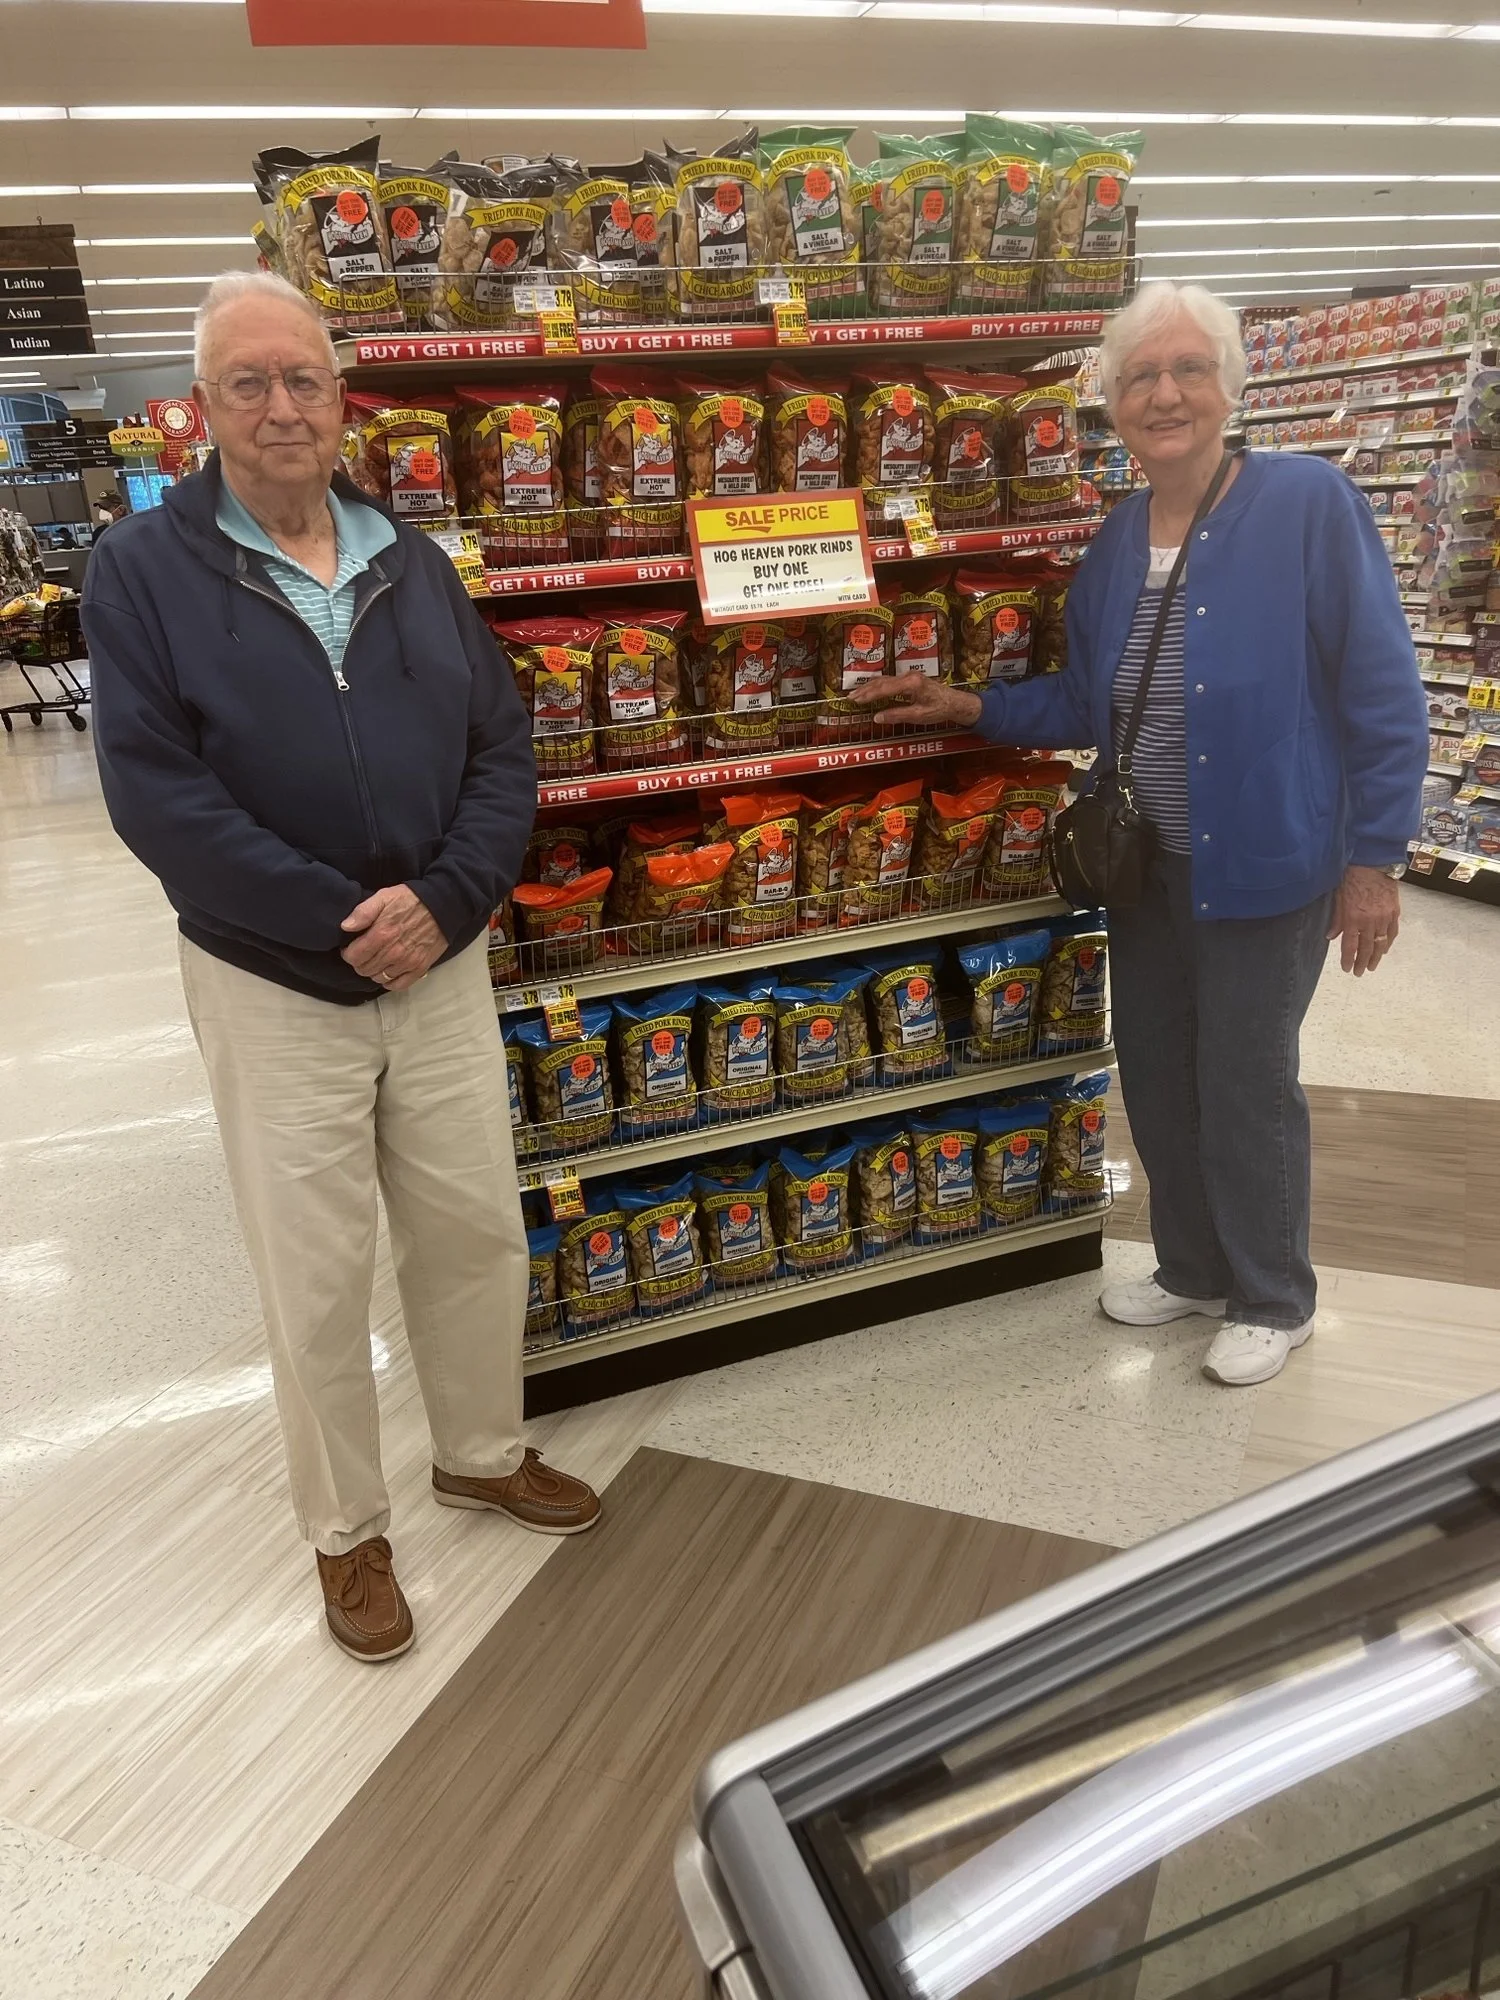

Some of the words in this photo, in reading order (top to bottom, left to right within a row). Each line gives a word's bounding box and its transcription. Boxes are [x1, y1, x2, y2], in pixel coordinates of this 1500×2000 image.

[775, 154, 796, 171] FRIED
[796, 151, 816, 162] PORK
[817, 151, 840, 163] RINDS
[682, 163, 706, 179] FRIED
[706, 162, 728, 173] PORK
[729, 162, 752, 176] RINDS
[297, 172, 320, 192] FRIED
[320, 168, 344, 182] PORK
[396, 181, 417, 193] PORK
[419, 182, 445, 199] RINDS
[483, 208, 505, 223] FRIED
[506, 207, 524, 217] PORK
[809, 238, 839, 248] VINEGAR
[811, 232, 828, 240] SALT
[714, 247, 733, 256] SALT
[714, 253, 740, 262] PEPPER
[345, 258, 365, 267] SALT
[345, 264, 375, 274] PEPPER
[4, 278, 45, 290] Latino
[788, 282, 804, 299] 3.78
[554, 289, 572, 307] 3.78
[7, 307, 41, 320] Asian
[824, 329, 831, 341] 1
[836, 328, 867, 341] GET
[872, 327, 879, 339] 1
[885, 326, 924, 339] FREE
[971, 323, 1003, 337] BUY
[1007, 322, 1015, 334] 1
[1019, 321, 1049, 334] GET
[1053, 321, 1060, 333] 1
[1064, 319, 1101, 331] FREE
[10, 336, 51, 349] Indian
[581, 337, 618, 351] BUY
[625, 337, 633, 349] 1
[638, 335, 671, 349] GET
[678, 334, 686, 347] 1
[691, 333, 733, 346] FREE
[360, 345, 401, 359] BUY
[408, 344, 416, 357] 1
[422, 343, 458, 357] GET
[466, 342, 474, 355] 1
[480, 340, 526, 355] FREE
[65, 420, 77, 435] 5
[162, 419, 192, 434] GUARANTEED
[513, 424, 531, 434] FREE
[113, 431, 160, 442] NATURAL
[640, 477, 671, 485] EXTREME
[398, 492, 438, 500] EXTREME
[510, 487, 547, 495] EXTREME
[409, 499, 427, 507] HOT
[915, 498, 930, 512] 3.78
[725, 509, 776, 528] SALE
[779, 505, 830, 522] PRICE
[460, 534, 478, 551] 3.78
[1002, 533, 1032, 546] BUY
[1037, 533, 1043, 543] 1
[1047, 530, 1077, 542] GET
[1079, 529, 1085, 539] 1
[714, 549, 738, 563] HOG
[741, 545, 785, 561] HEAVEN
[788, 543, 817, 558] PORK
[820, 540, 853, 554] RINDS
[875, 545, 904, 558] GET
[637, 565, 672, 580] BUY
[677, 565, 684, 576] 1
[753, 564, 779, 579] BUY
[782, 561, 809, 576] ONE
[489, 577, 524, 592] GET
[530, 576, 538, 588] 1
[543, 573, 586, 587] FREE
[743, 585, 765, 598] GET
[624, 642, 641, 651] FREE
[615, 700, 650, 709] EXTREME
[625, 706, 641, 714] HOT
[1442, 740, 1460, 749] JELL-O
[818, 754, 849, 767] BUY
[854, 753, 860, 763] 1
[865, 749, 893, 761] GET
[899, 747, 906, 756] 1
[909, 742, 943, 755] FREE
[637, 776, 672, 791] BUY
[675, 776, 683, 787] 1
[688, 771, 720, 785] GET
[723, 769, 730, 780] 1
[735, 764, 773, 778] FREE
[548, 788, 588, 803] FREE
[763, 886, 788, 895] BAR-B-Q
[523, 990, 539, 1005] 3.78
[558, 984, 574, 999] 3.78
[634, 1023, 653, 1036] FRIED
[654, 1018, 672, 1029] PORK
[672, 1017, 690, 1027] RINDS
[567, 1046, 585, 1057] PORK
[585, 1042, 605, 1052] RINDS
[732, 1065, 762, 1073] ORIGINAL
[651, 1080, 682, 1090] ORIGINAL
[568, 1103, 600, 1114] ORIGINAL
[561, 1165, 577, 1178] 3.78
[526, 1173, 542, 1187] 3.78
[659, 1257, 689, 1270] ORIGINAL
[593, 1274, 624, 1287] ORIGINAL
